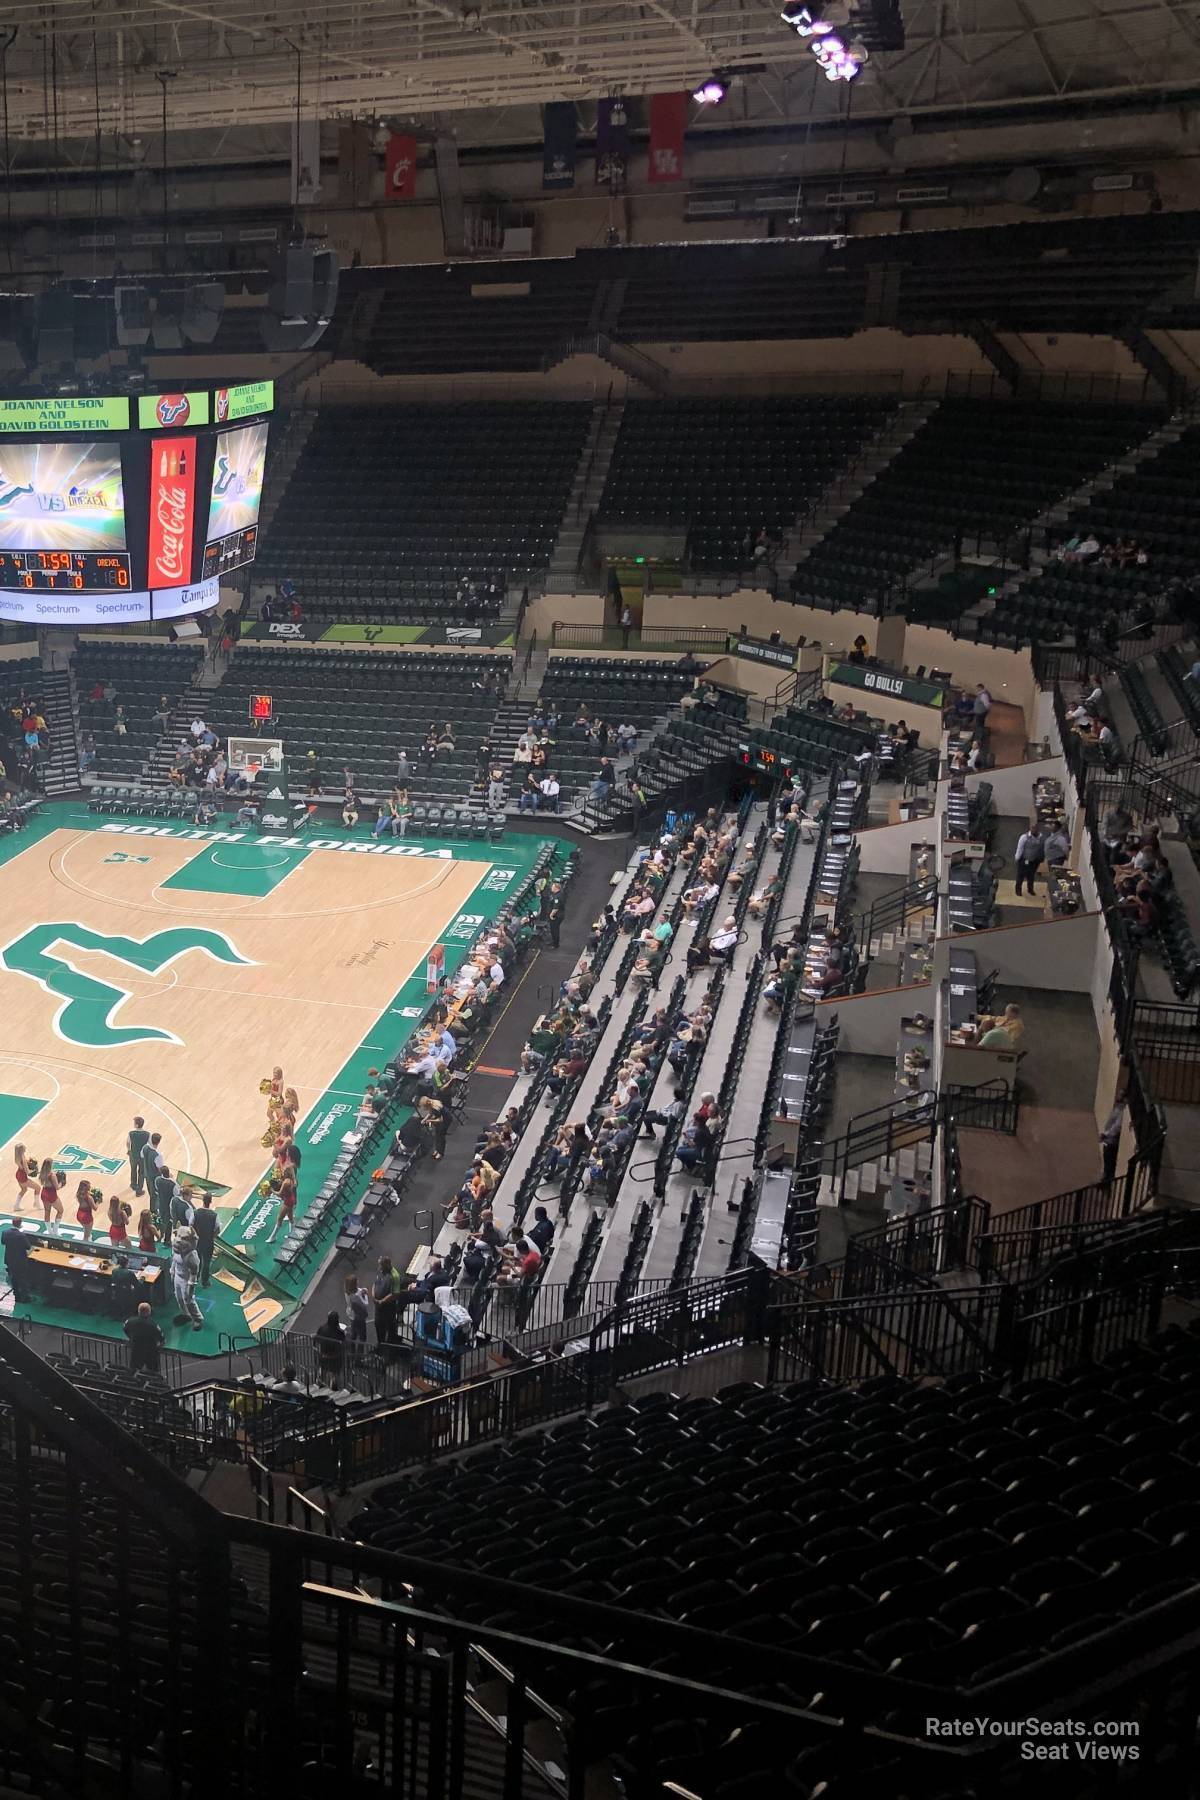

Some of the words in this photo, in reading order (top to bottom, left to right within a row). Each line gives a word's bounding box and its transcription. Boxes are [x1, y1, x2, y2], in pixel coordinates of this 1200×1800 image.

[1, 400, 50, 411] JOANNE
[54, 399, 104, 409] NELSON
[39, 410, 66, 420] AND
[39, 419, 109, 430] GOLDSTEIN
[38, 553, 71, 570] 7:59
[118, 569, 128, 586] 0
[36, 603, 78, 615] Spectrum
[96, 601, 142, 615] Spectrum
[269, 623, 303, 634] DEX
[864, 672, 877, 688] GO
[876, 675, 903, 695] BULLS!
[97, 823, 247, 842] SOUTH
[253, 835, 453, 860] FLORIDA
